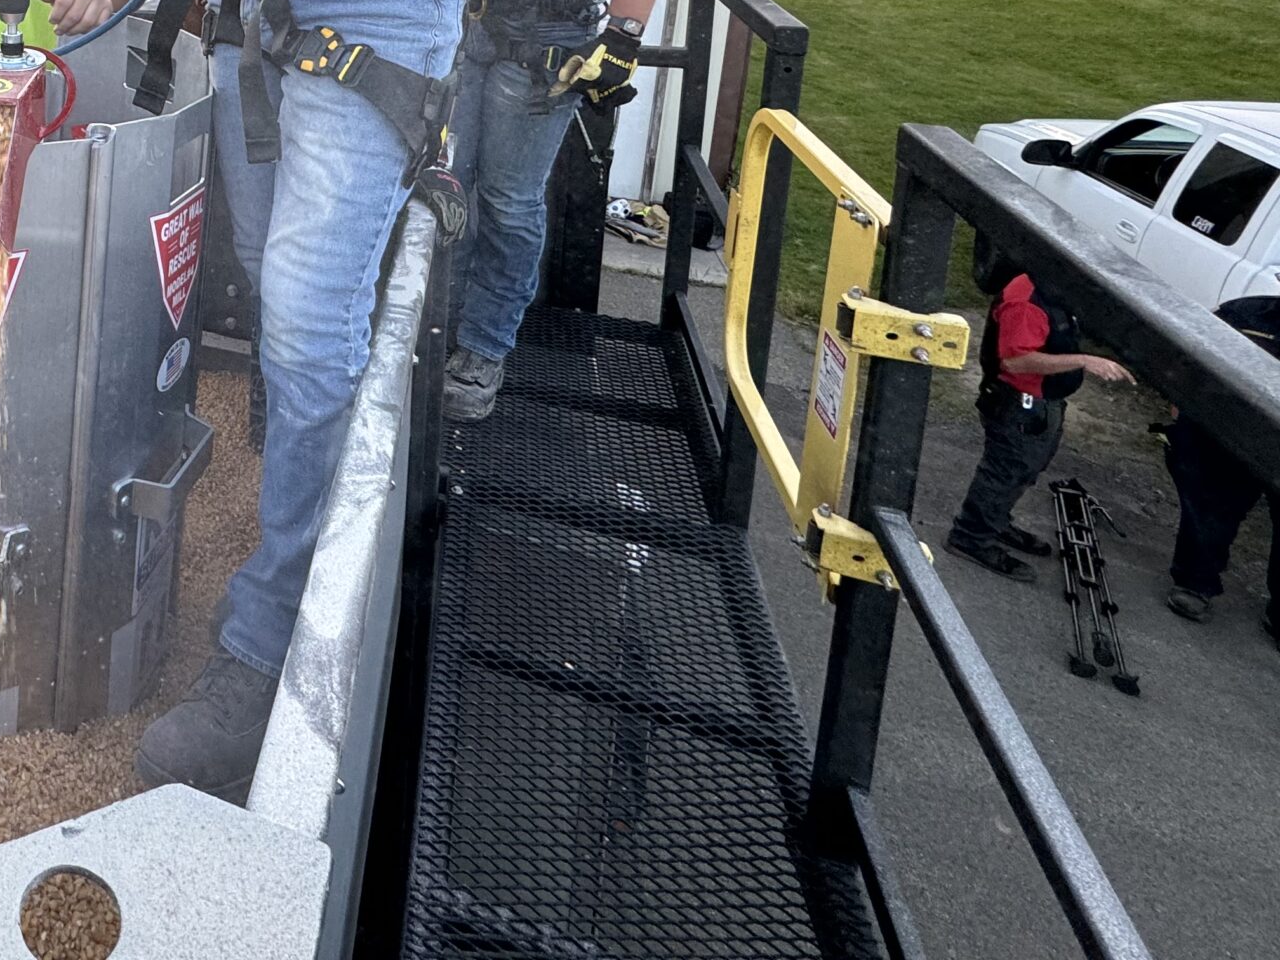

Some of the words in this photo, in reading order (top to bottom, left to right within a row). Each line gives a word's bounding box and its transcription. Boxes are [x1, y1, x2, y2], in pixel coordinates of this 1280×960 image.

[161, 208, 189, 242] GREAT
[188, 197, 204, 223] WAL
[180, 225, 190, 248] OF
[167, 238, 198, 278] RESCUE
